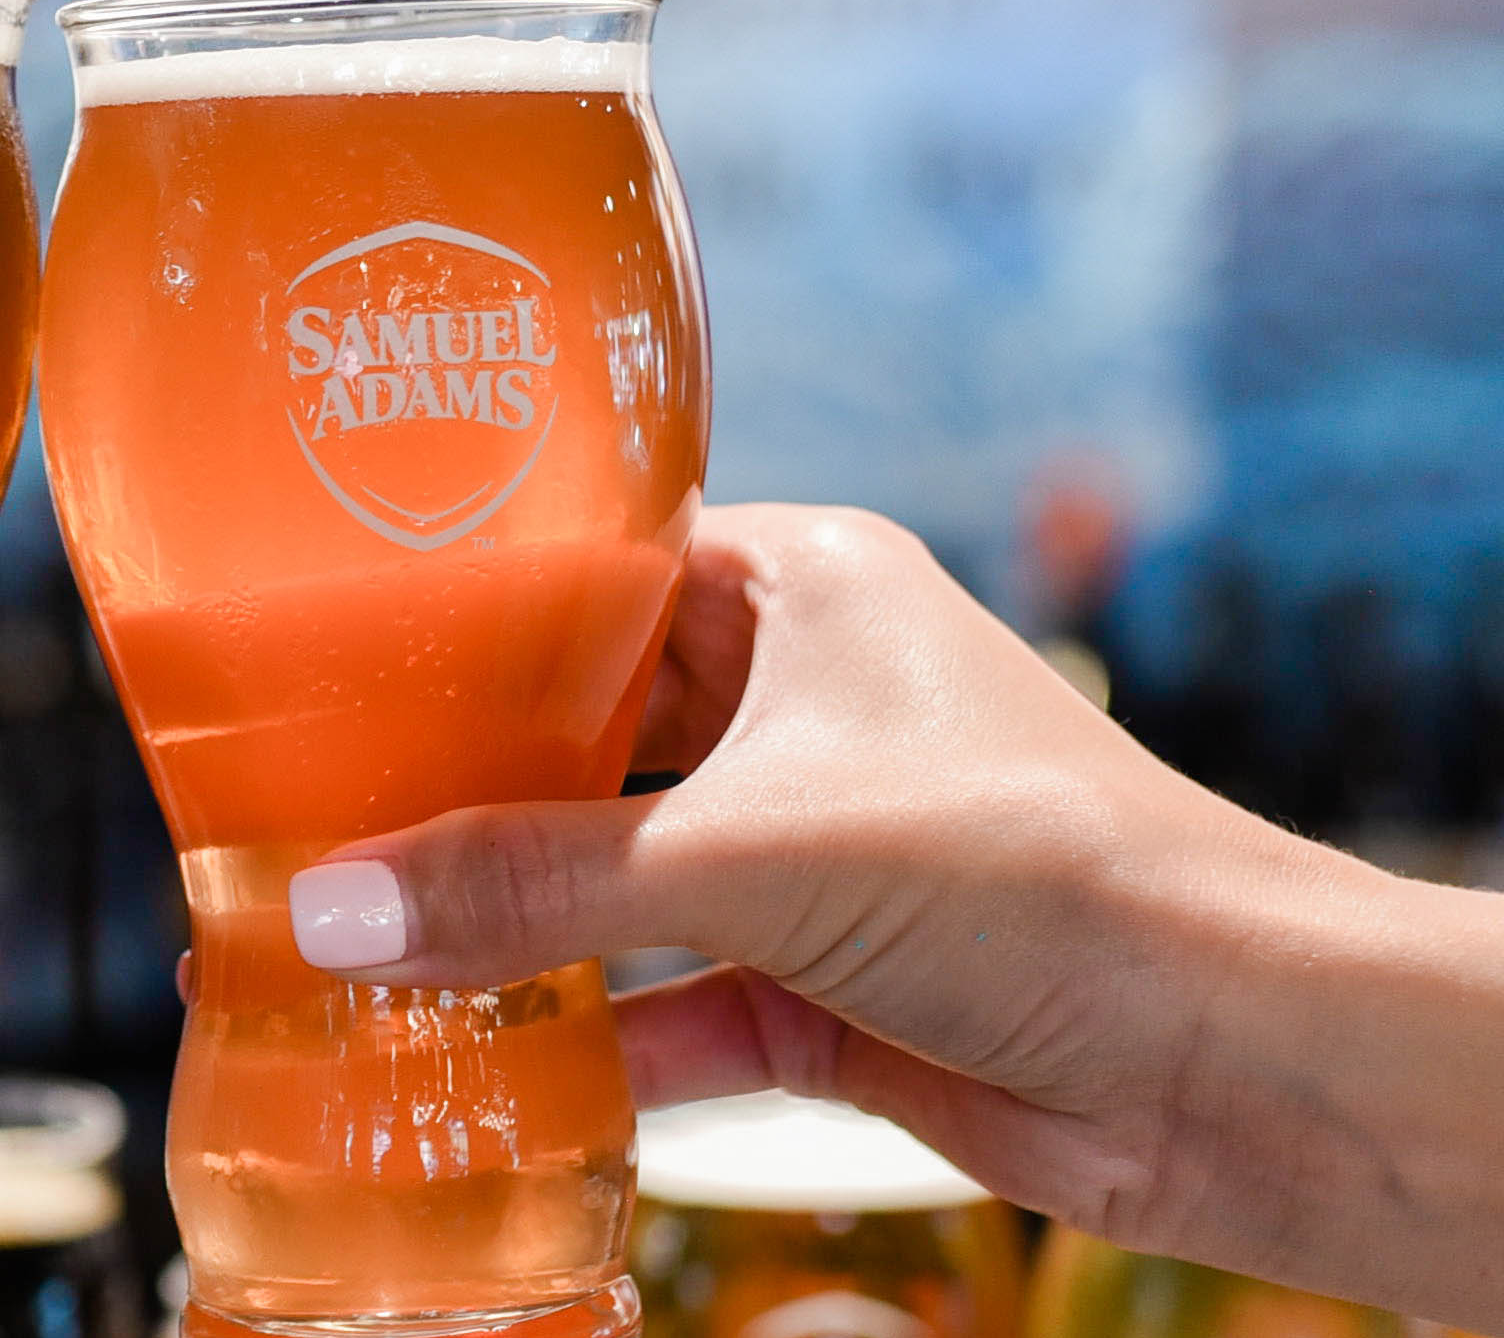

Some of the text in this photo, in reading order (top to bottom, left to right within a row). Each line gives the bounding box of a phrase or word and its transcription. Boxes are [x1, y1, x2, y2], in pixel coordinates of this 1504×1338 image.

[287, 299, 557, 376] SAMUEL
[311, 369, 535, 441] ADAMS
[472, 537, 496, 550] TM
